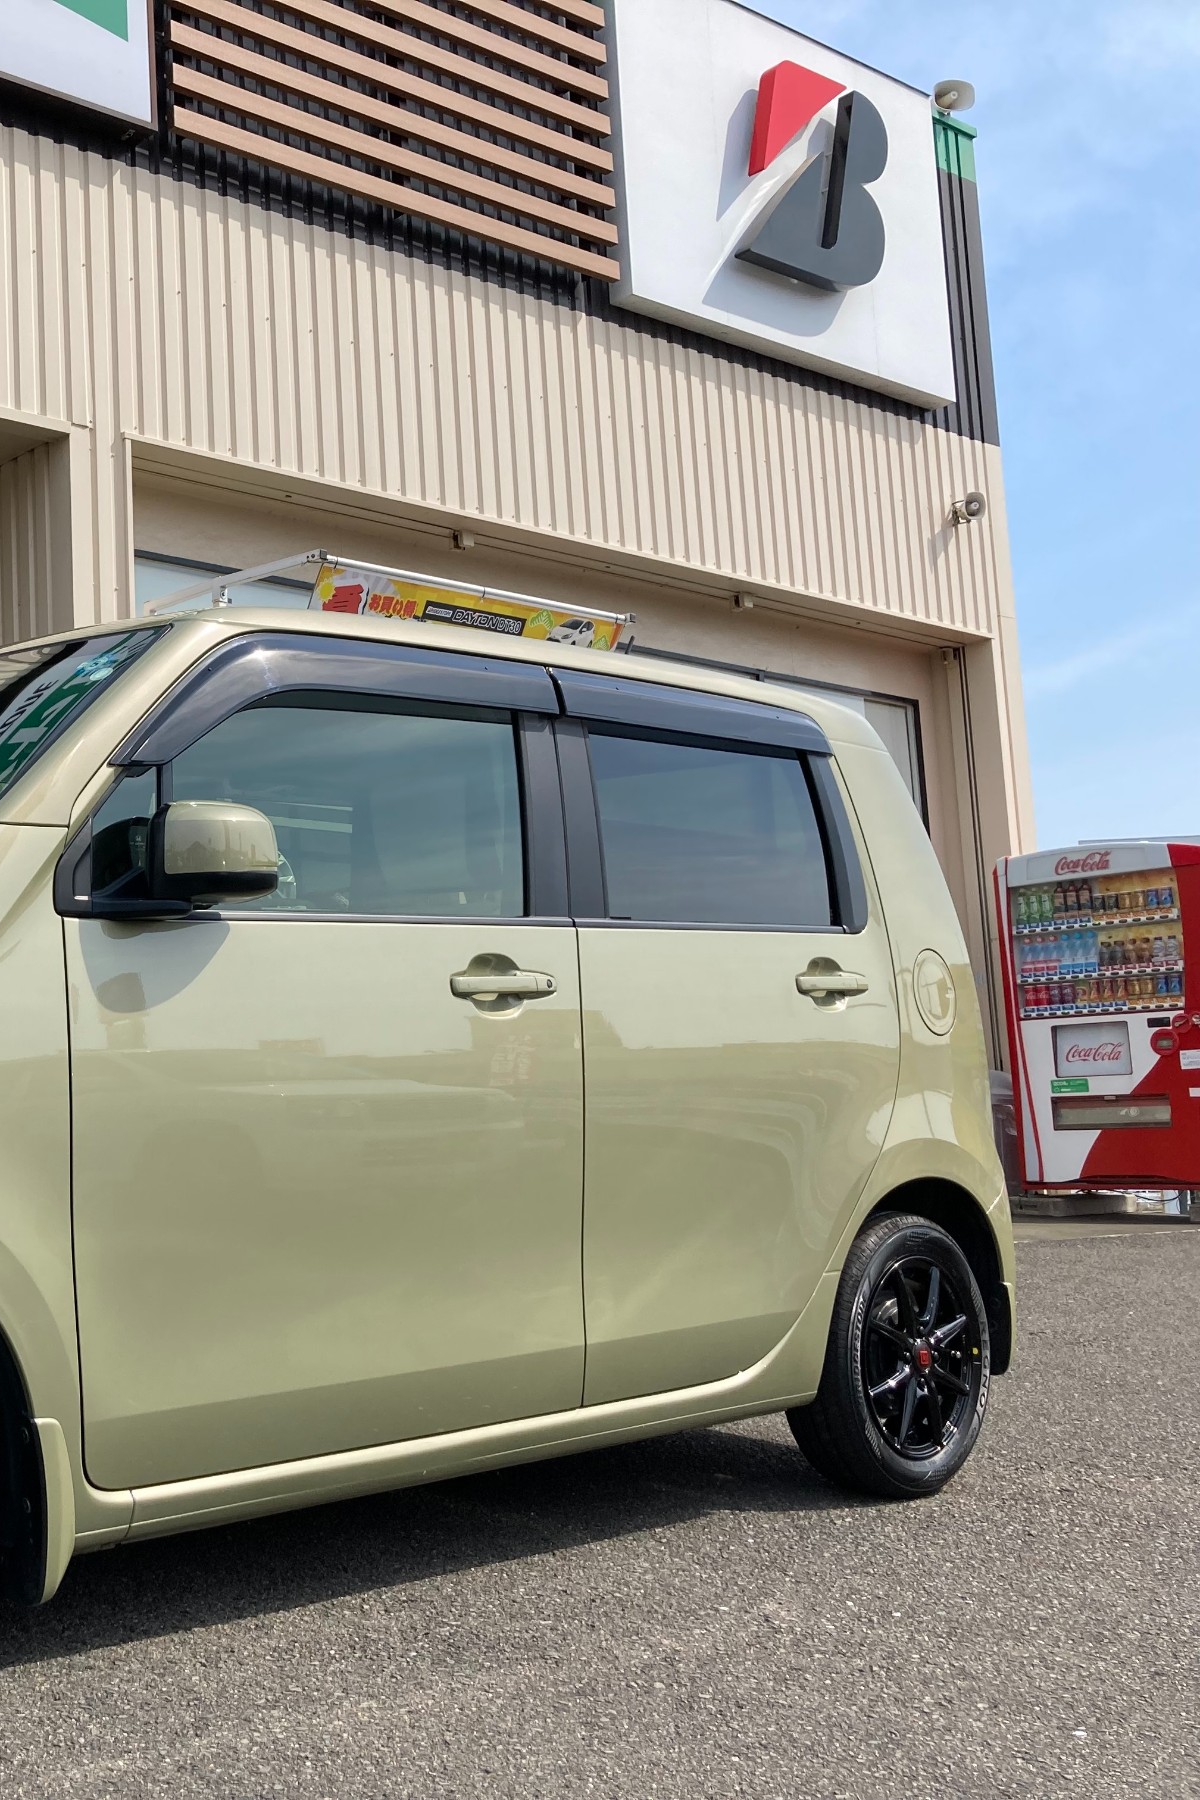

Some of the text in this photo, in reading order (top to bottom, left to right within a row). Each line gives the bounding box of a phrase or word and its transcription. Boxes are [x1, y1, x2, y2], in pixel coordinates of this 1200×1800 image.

[452, 609, 499, 630] DAYTON
[1054, 851, 1111, 875] Coca-Cola
[1065, 1042, 1122, 1063] Coca-Cola
